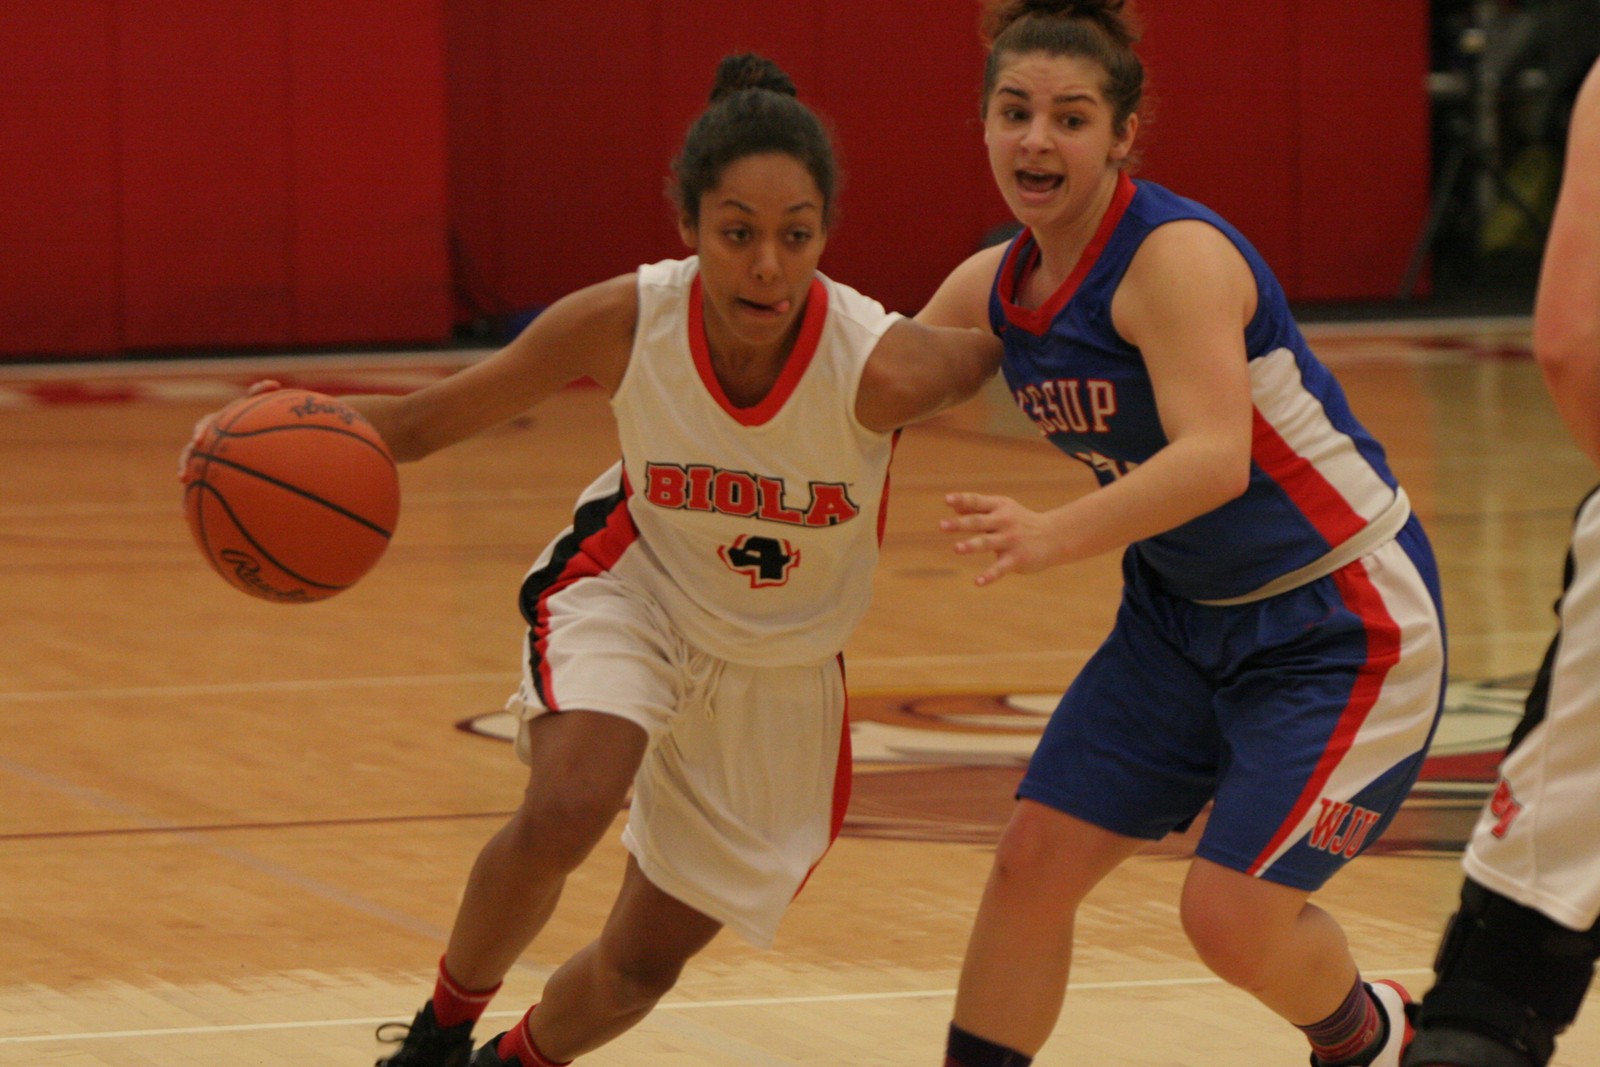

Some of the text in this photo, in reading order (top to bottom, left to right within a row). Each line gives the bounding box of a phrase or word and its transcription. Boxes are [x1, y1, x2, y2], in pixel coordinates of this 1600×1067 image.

[645, 461, 860, 528] BIOLA
[717, 533, 801, 589] 4
[1308, 798, 1382, 859] WJU
